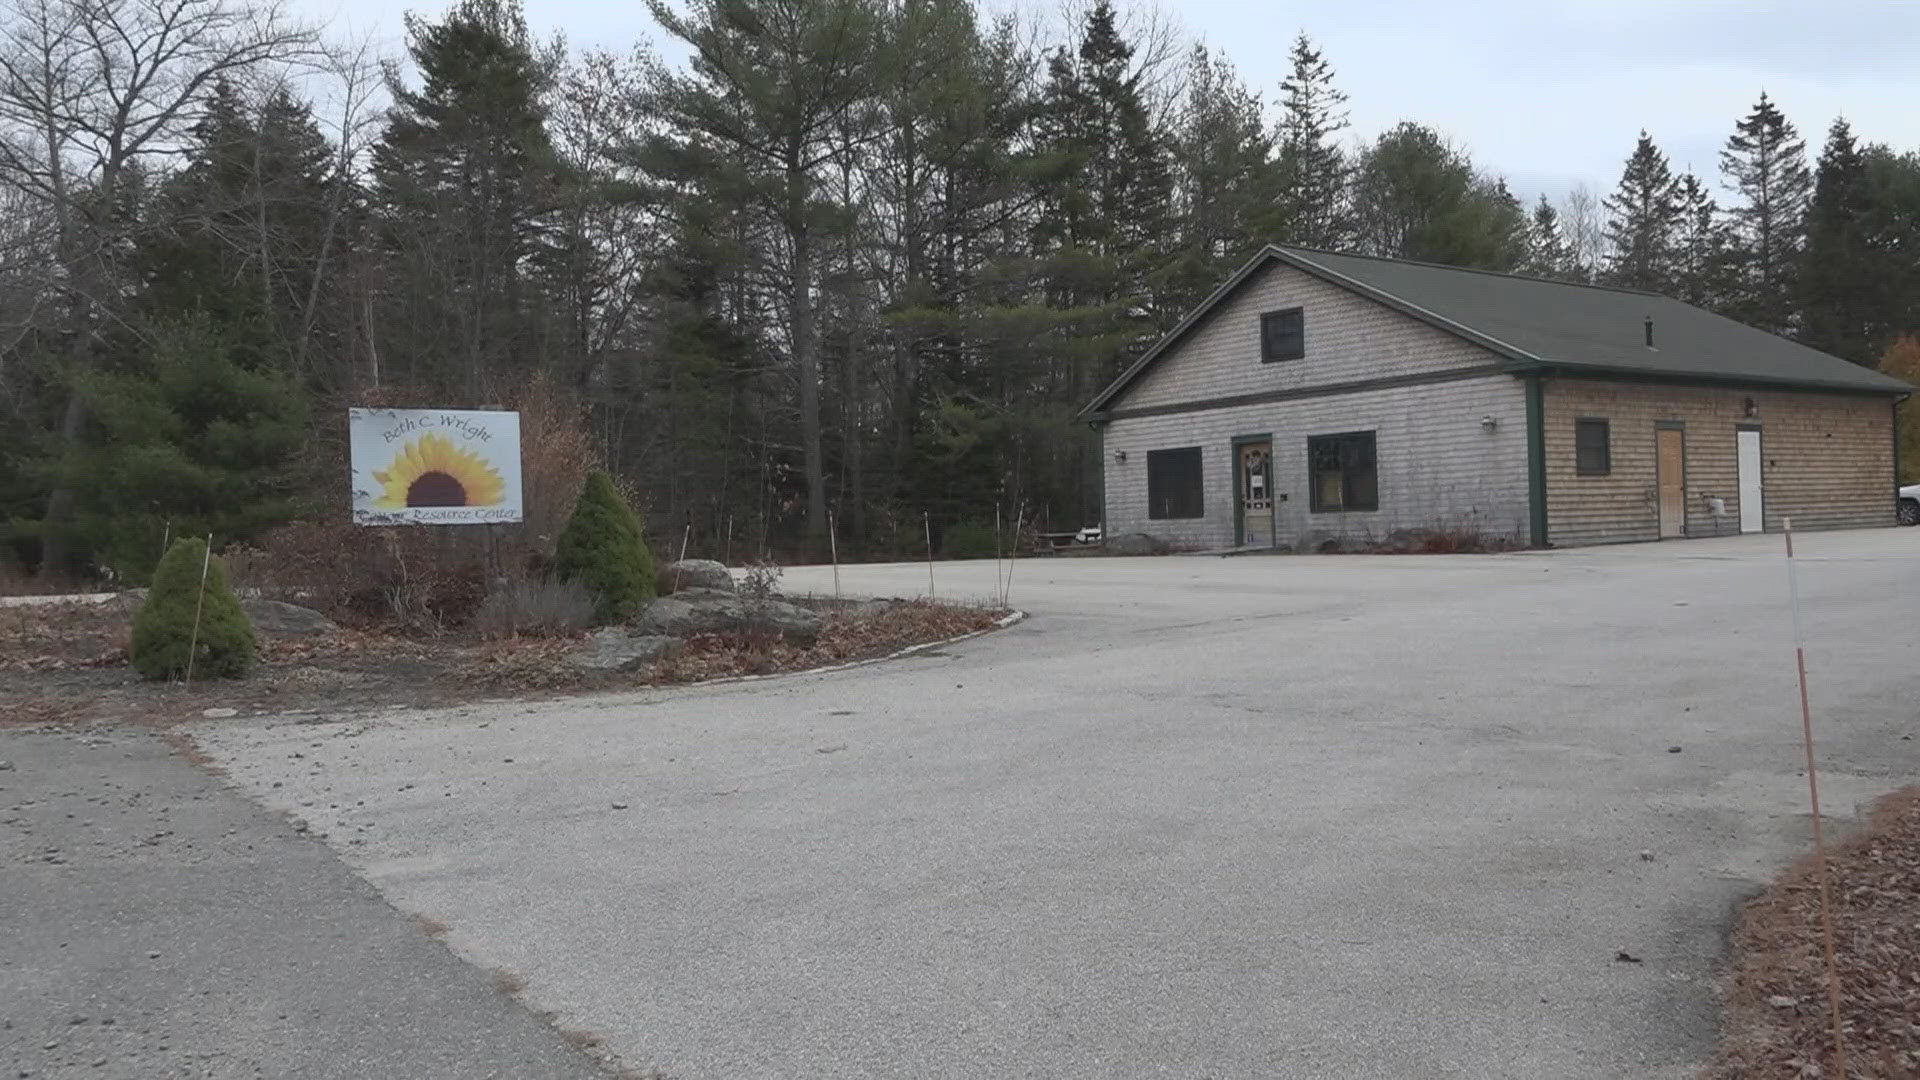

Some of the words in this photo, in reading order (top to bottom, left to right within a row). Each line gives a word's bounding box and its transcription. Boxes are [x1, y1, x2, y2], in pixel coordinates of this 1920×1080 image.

[384, 416, 415, 443] Beth
[440, 415, 493, 443] Wright
[413, 509, 472, 520] Resource
[475, 508, 517, 519] Center
